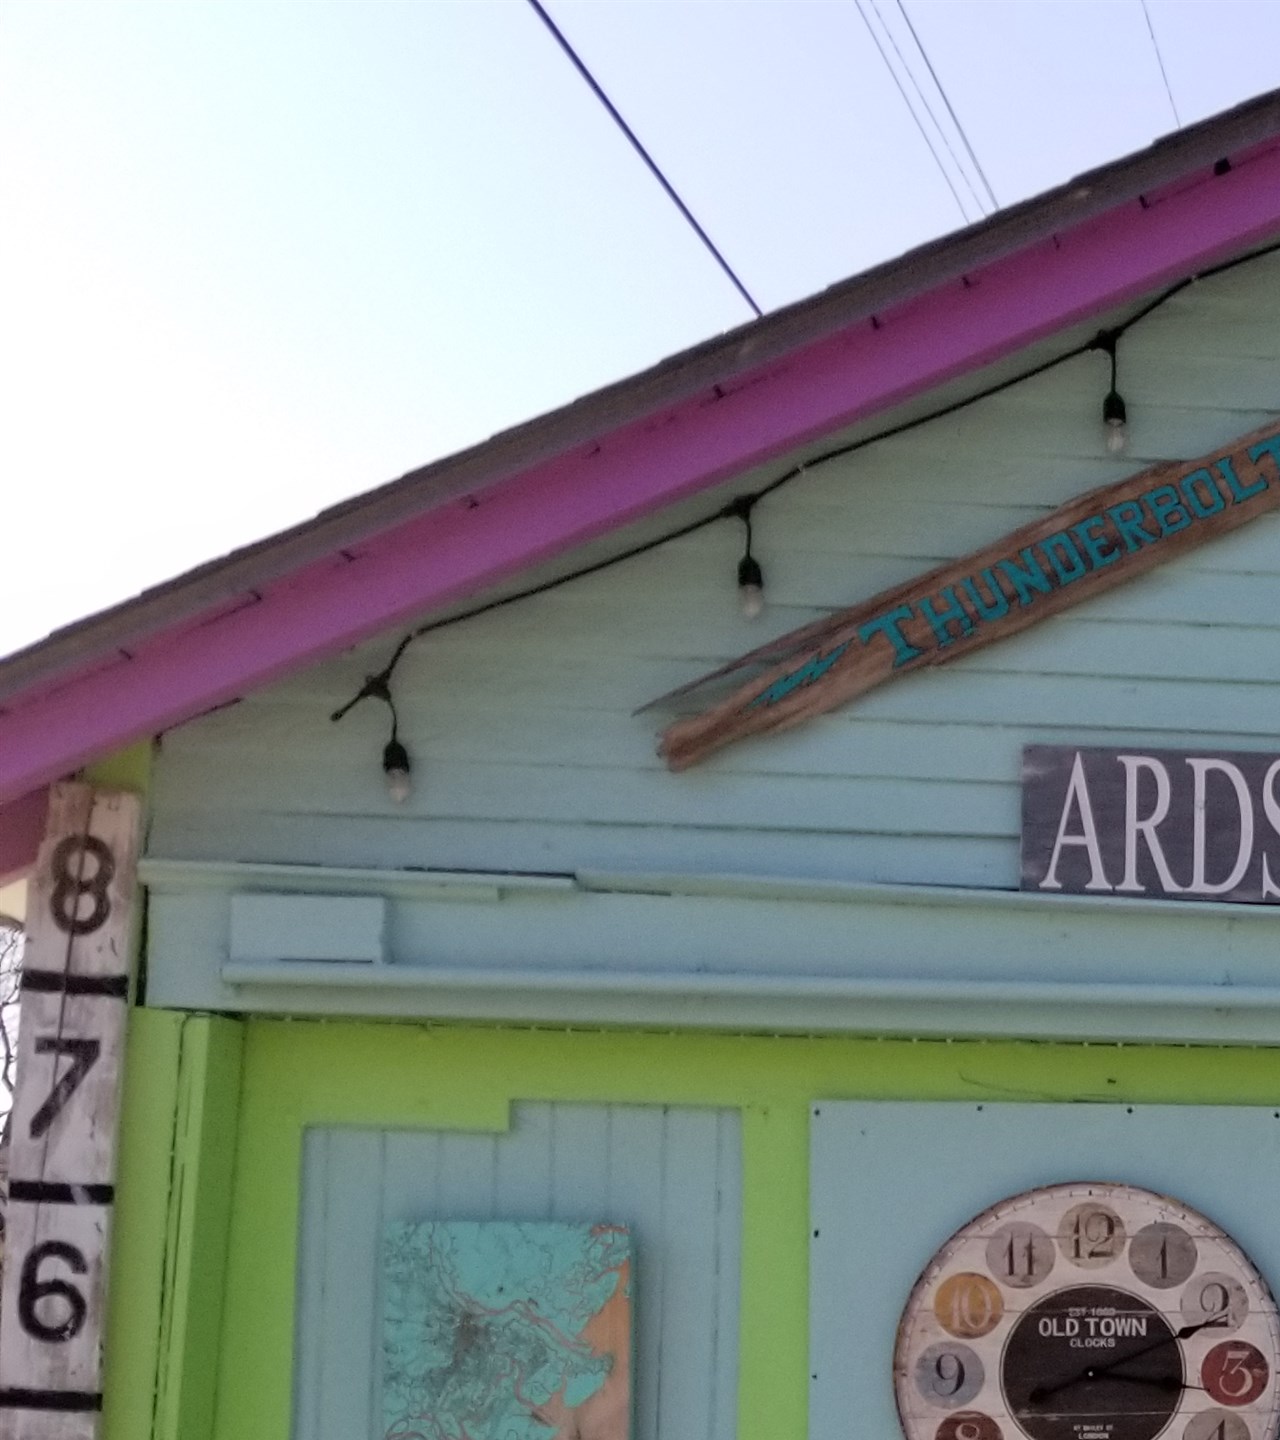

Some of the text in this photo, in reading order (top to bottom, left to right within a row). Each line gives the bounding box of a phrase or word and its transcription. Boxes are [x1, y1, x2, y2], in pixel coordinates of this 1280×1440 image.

[48, 835, 115, 934] 8
[29, 1038, 102, 1139] 7
[1004, 1232, 1035, 1277] 11
[1072, 1212, 1115, 1260] 12
[1157, 1233, 1169, 1280] 1
[17, 1243, 89, 1344] 6
[949, 1286, 992, 1331] 10
[1200, 1281, 1230, 1329] 2
[1038, 1317, 1148, 1337] OLD TOWN
[1069, 1338, 1116, 1349] CLOCKS
[932, 1353, 965, 1397] 9
[1218, 1351, 1254, 1397] 3
